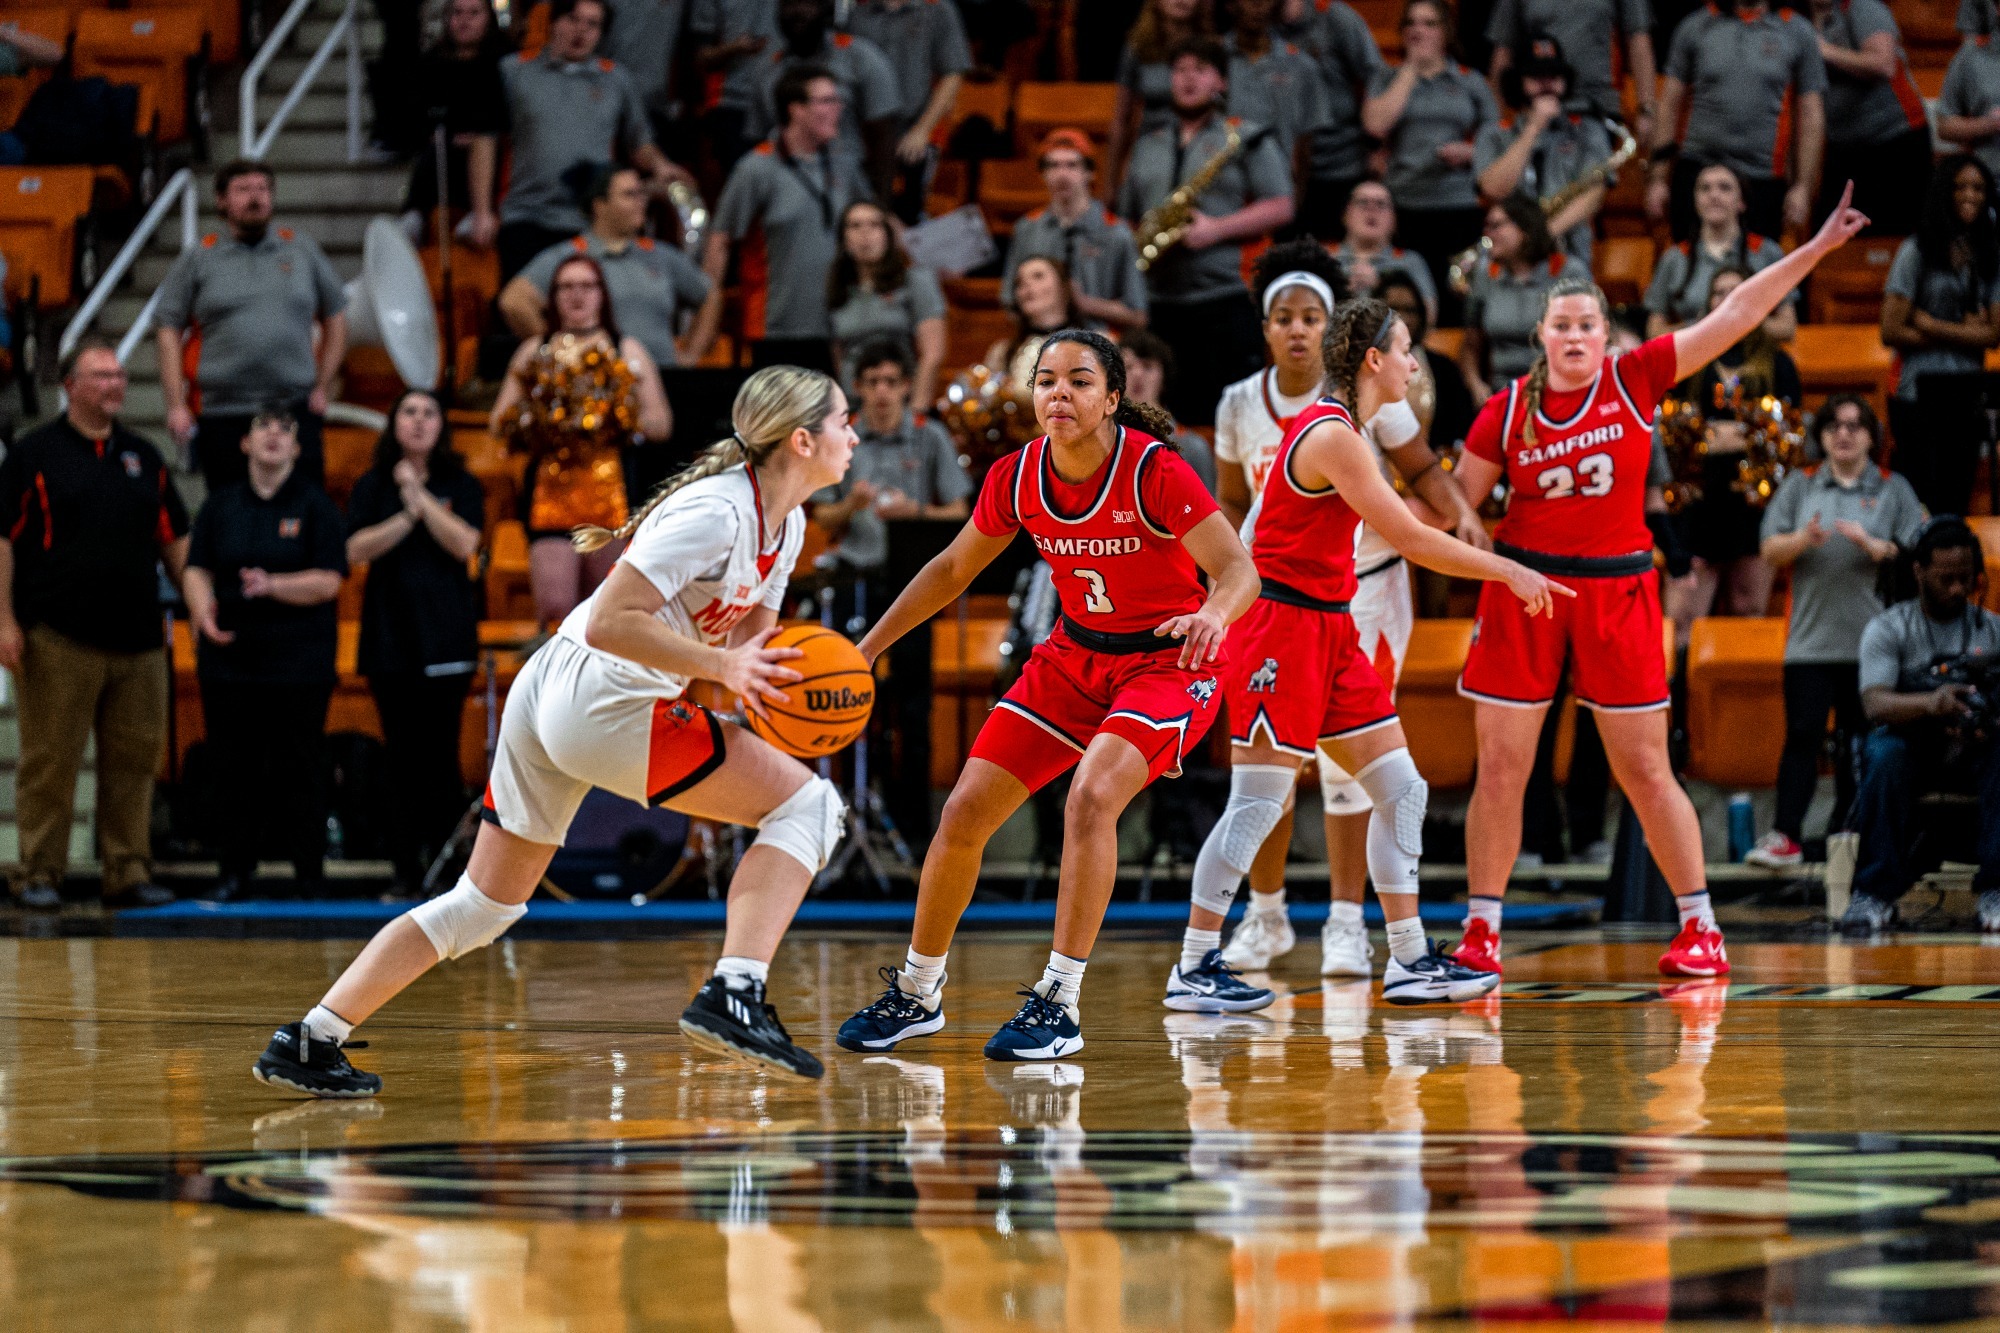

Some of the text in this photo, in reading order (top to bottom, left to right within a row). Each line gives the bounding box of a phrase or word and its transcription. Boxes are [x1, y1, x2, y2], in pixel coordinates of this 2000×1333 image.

[1518, 422, 1624, 467] SAMFORD
[1537, 452, 1614, 500] 23
[1033, 533, 1142, 557] SAMFORD
[1072, 568, 1116, 614] 3
[804, 687, 872, 711] Wilson
